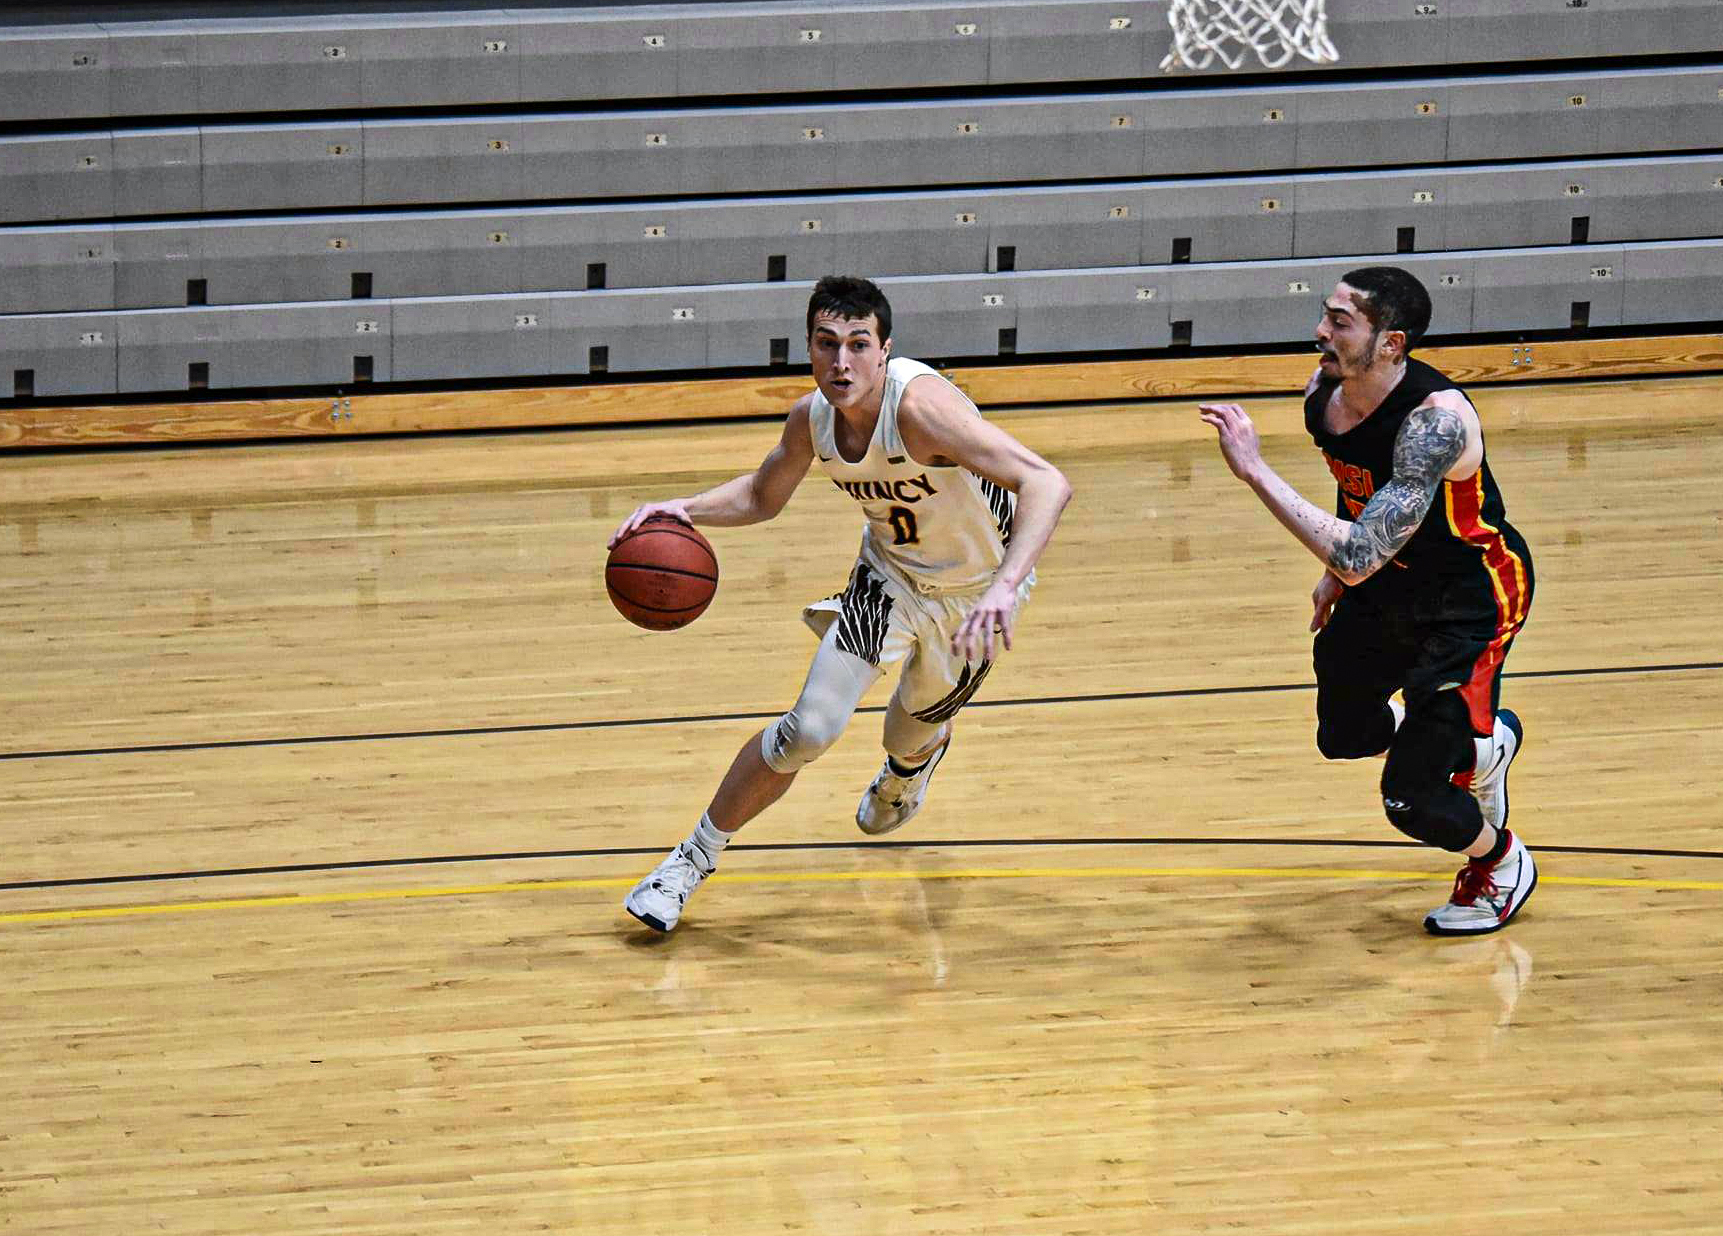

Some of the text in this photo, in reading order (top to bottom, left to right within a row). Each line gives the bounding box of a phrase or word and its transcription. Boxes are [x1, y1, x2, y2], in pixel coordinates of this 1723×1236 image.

[1423, 6, 1429, 15] 9
[808, 32, 813, 40] 5
[493, 43, 498, 51] 3
[332, 48, 338, 56] 2
[1572, 97, 1582, 106] 10
[495, 141, 501, 149] 3
[335, 146, 341, 155] 2
[1569, 185, 1579, 194] 10
[1421, 193, 1426, 201] 9
[1116, 208, 1122, 216] 7
[1448, 276, 1453, 284] 9
[364, 323, 370, 331] 2
[832, 473, 938, 503] UINCY
[888, 506, 920, 545] 0
